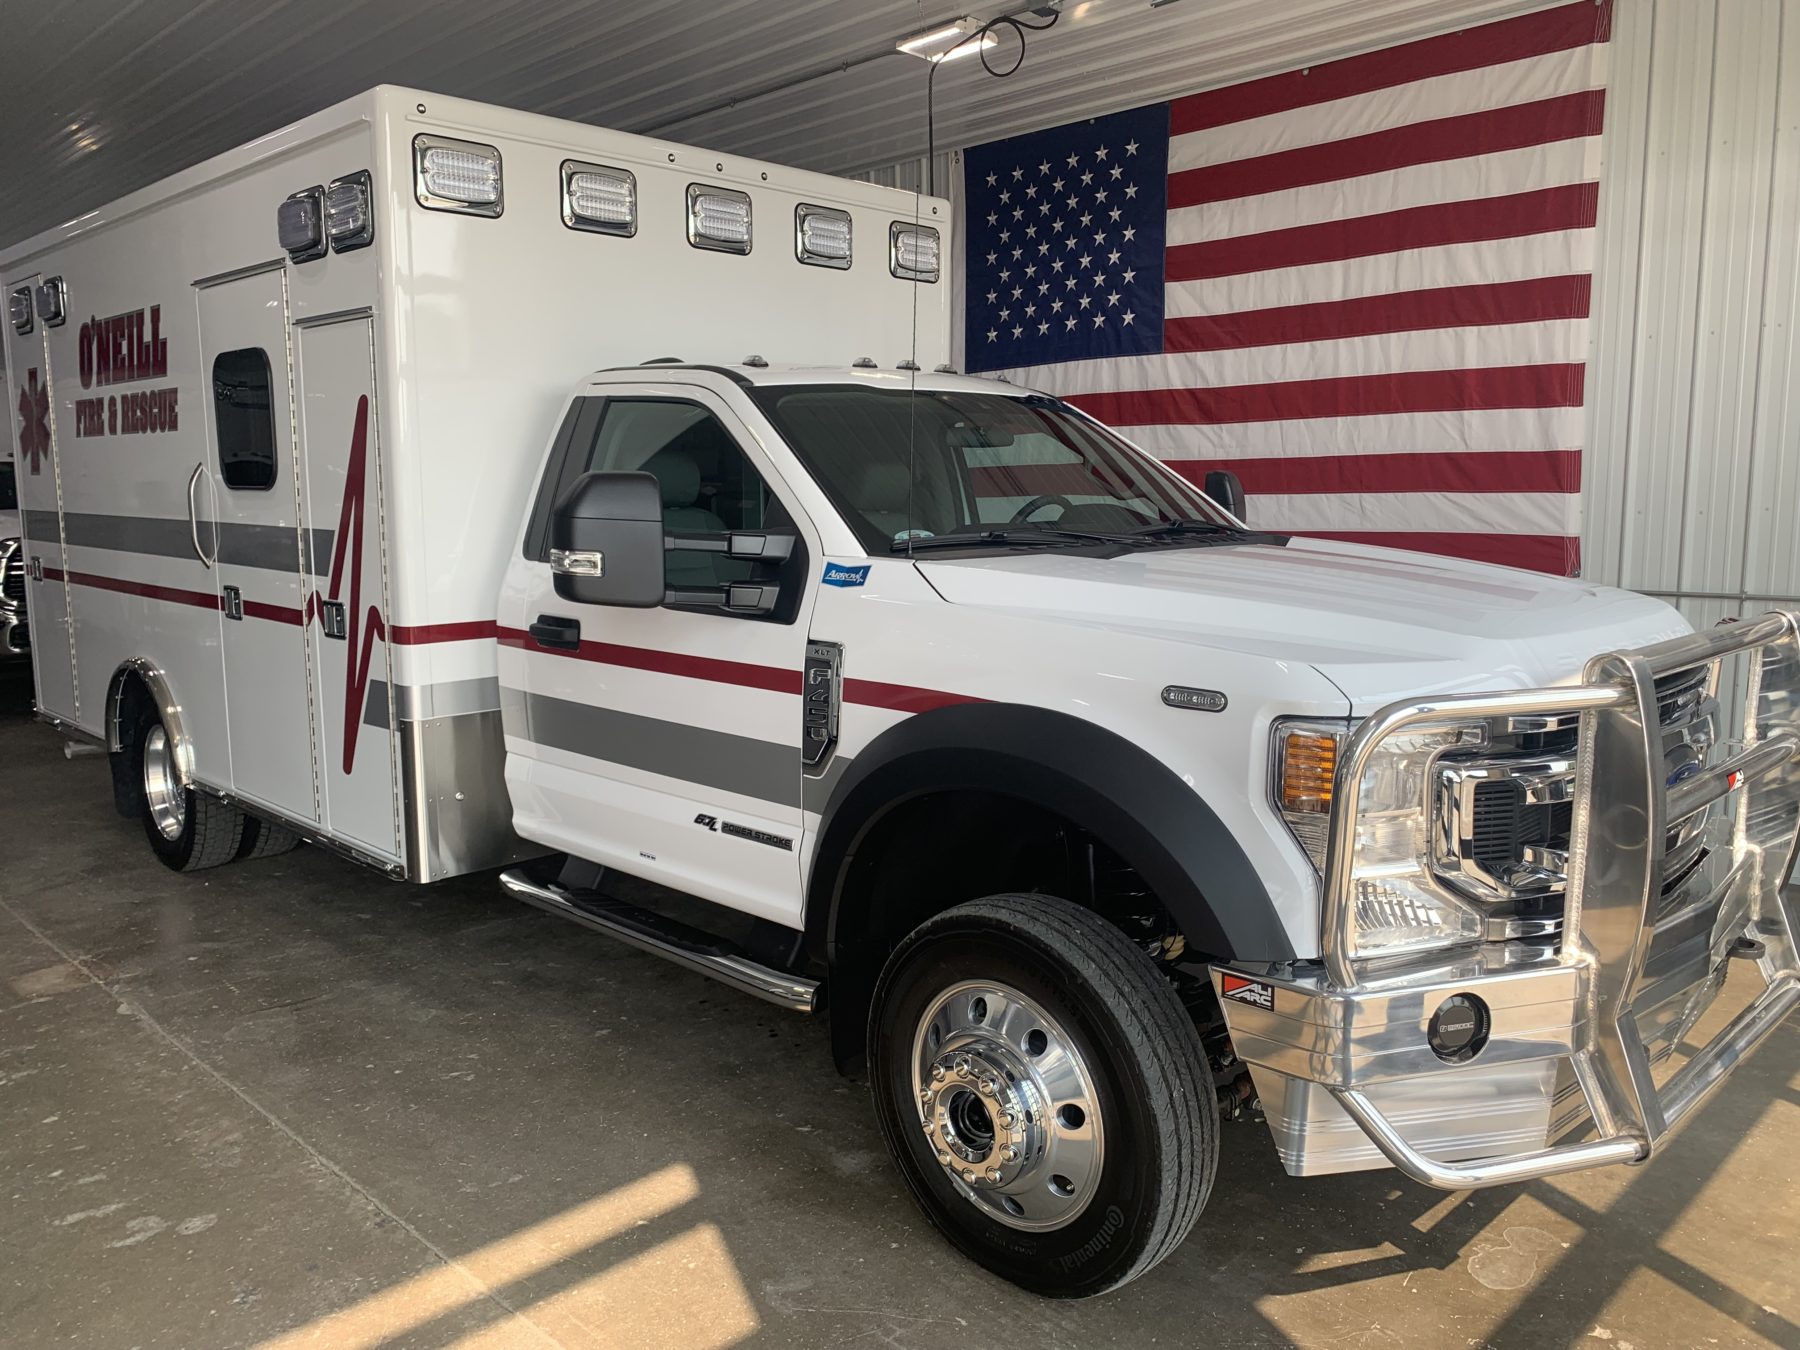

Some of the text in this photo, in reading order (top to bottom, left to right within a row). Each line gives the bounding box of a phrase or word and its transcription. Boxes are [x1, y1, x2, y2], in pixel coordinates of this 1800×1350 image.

[79, 304, 167, 390] O'NEILL
[76, 388, 178, 438] FIRE & RESCUE
[813, 648, 830, 656] XLT
[722, 822, 752, 837] POWER
[755, 831, 791, 847] STROKE
[1235, 991, 1272, 1006] ARC
[1059, 1204, 1125, 1272] Continental
